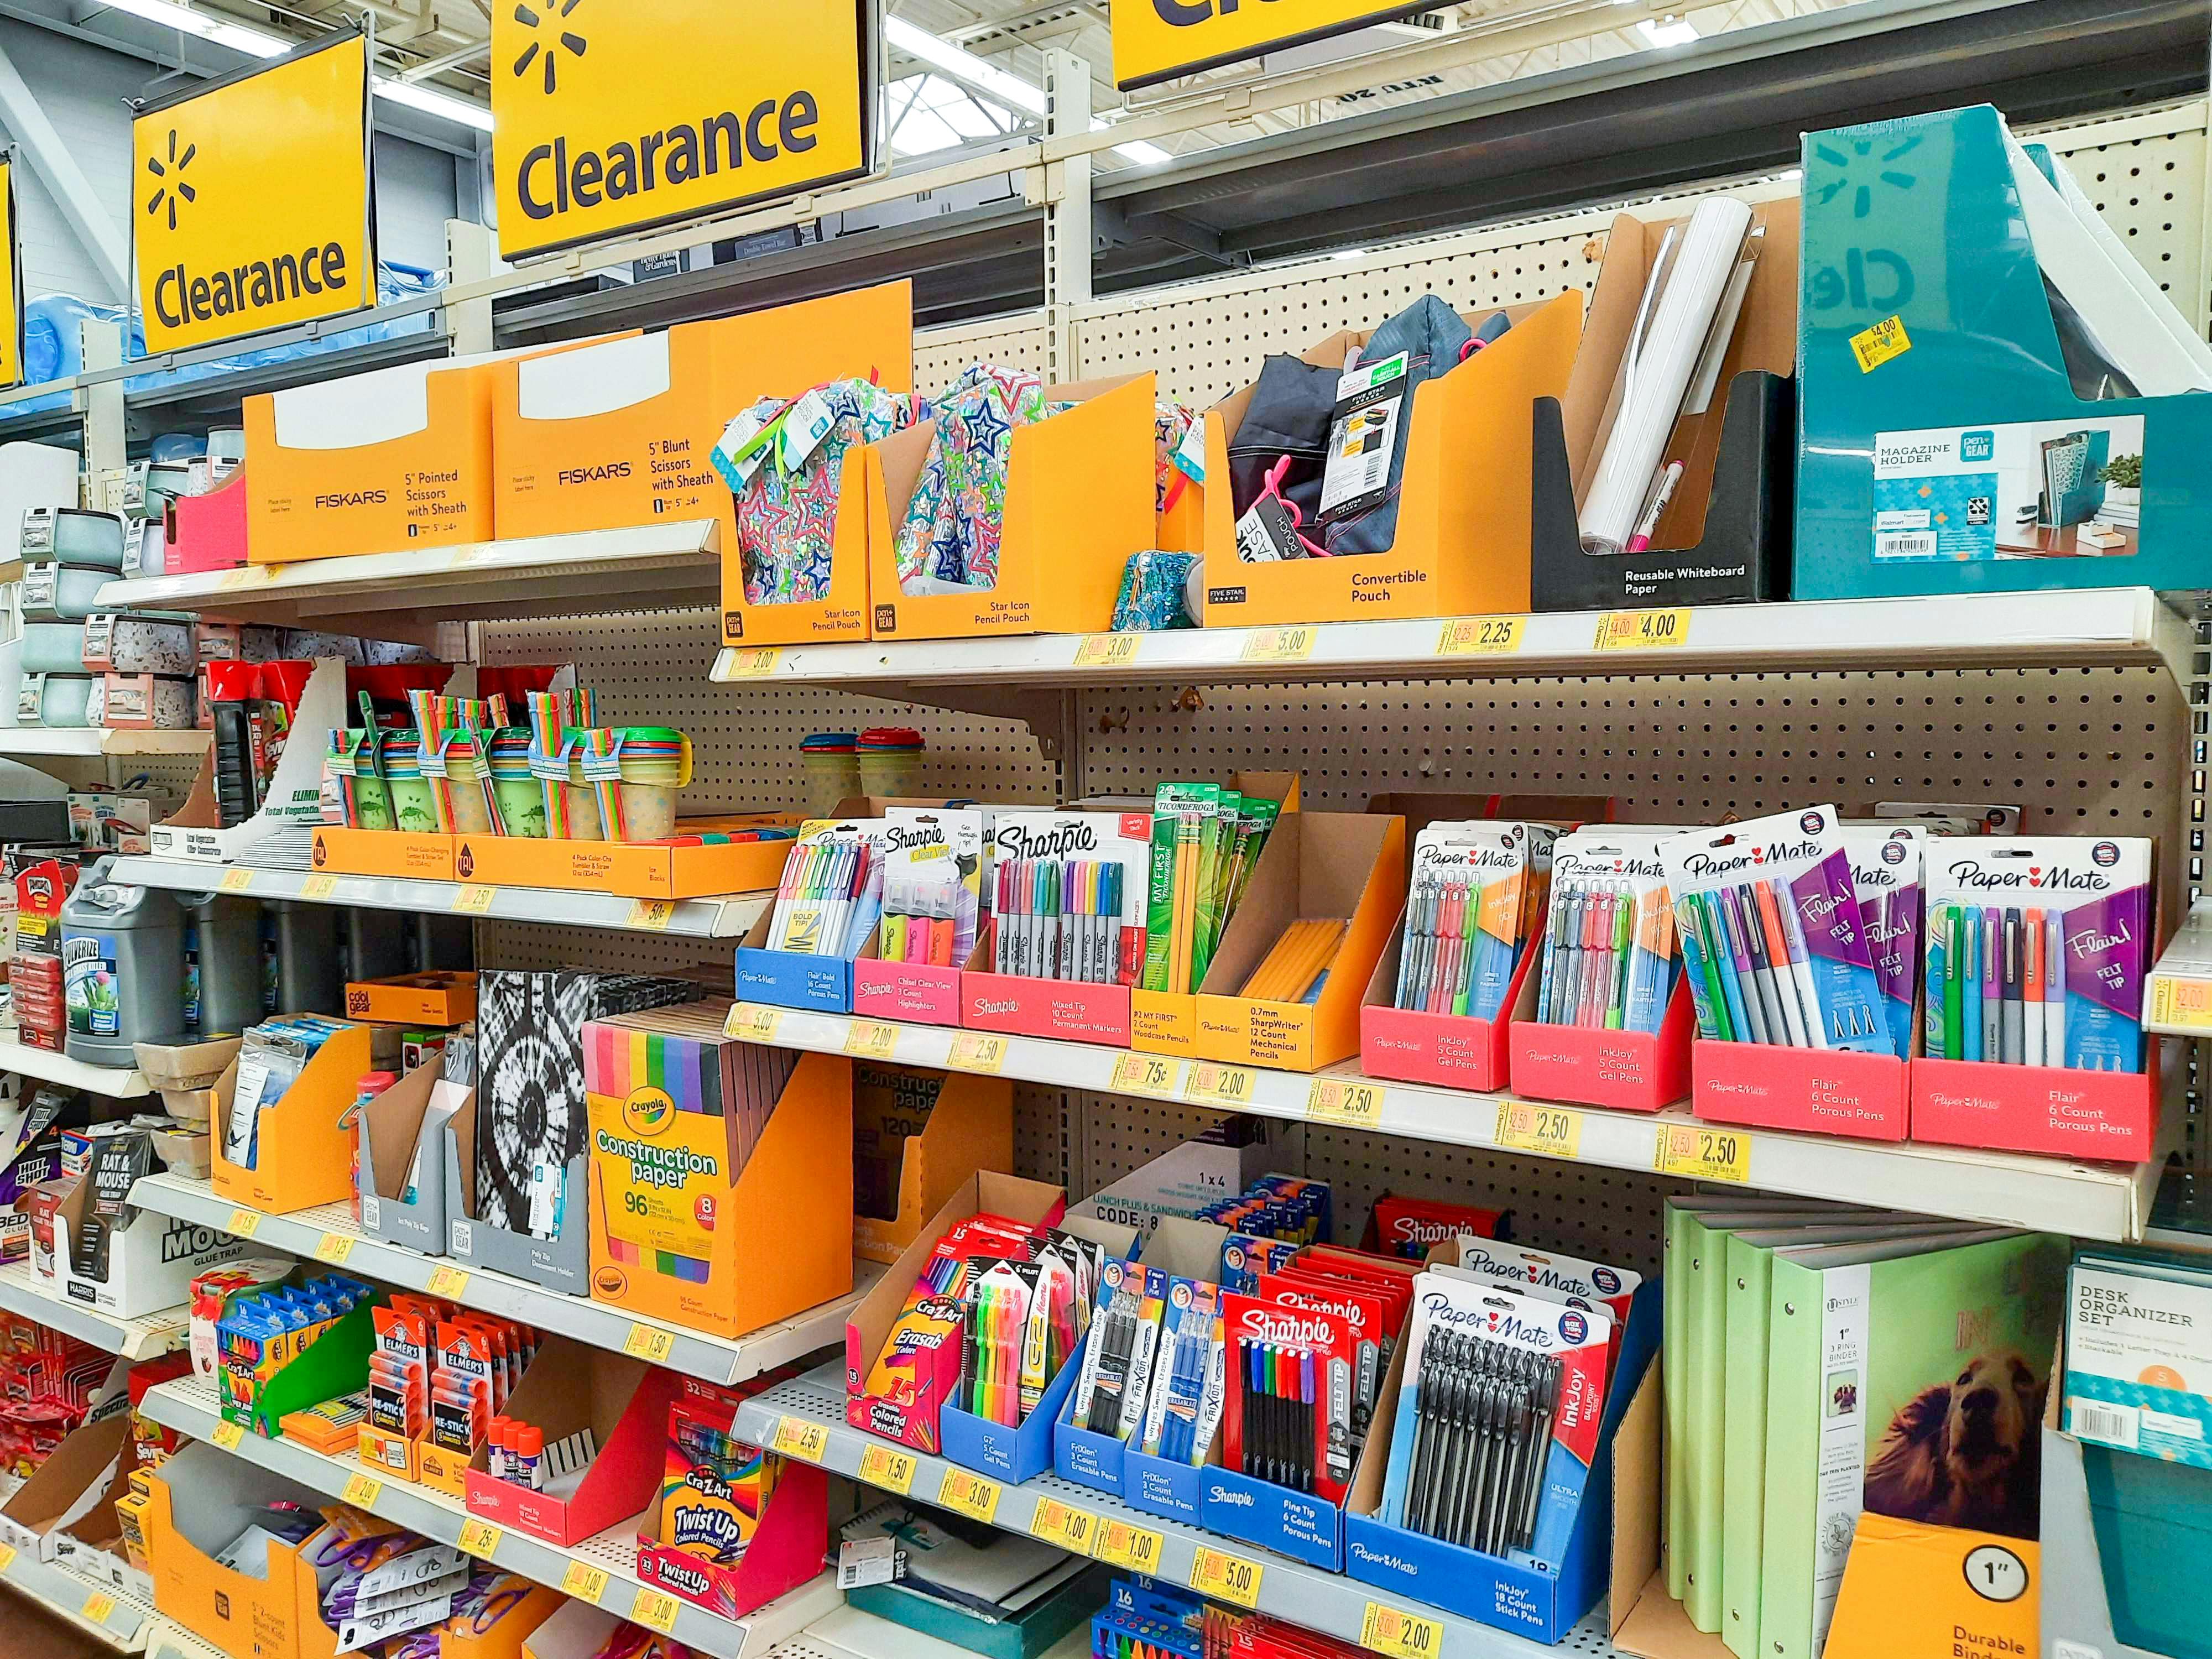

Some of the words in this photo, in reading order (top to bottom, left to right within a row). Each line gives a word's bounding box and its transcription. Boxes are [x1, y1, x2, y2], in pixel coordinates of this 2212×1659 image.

[518, 90, 818, 220] Clearance
[154, 242, 346, 328] Clearance
[1871, 319, 1896, 336] $4.00
[649, 442, 659, 455] 5"
[663, 439, 690, 454] Blunt
[1881, 444, 1950, 456] MAGAZINE
[1966, 445, 1989, 457] GEAR
[650, 459, 691, 474] Scissors
[1880, 455, 1932, 465] HOLDER
[559, 462, 632, 486] FISKARS
[652, 476, 674, 491] with
[677, 471, 714, 487] Sheath
[315, 490, 387, 509] FISKARS
[406, 489, 446, 501] Scissors
[407, 503, 429, 517] with
[432, 501, 467, 515] Sheath
[1277, 517, 1299, 552] POUCH
[1352, 570, 1427, 586] Convertible
[1626, 570, 1674, 582] Reusable
[1677, 565, 1745, 580] Whiteboard
[1352, 588, 1391, 602] Pouch
[1626, 584, 1657, 597] Paper
[812, 621, 835, 630] Pencil
[837, 619, 860, 629] Pouch
[975, 613, 999, 624] Pencil
[1001, 612, 1030, 623] Pouch
[1640, 614, 1676, 637] $4.00
[728, 623, 741, 634] GEAR
[1480, 622, 1513, 644] $2.25
[1279, 630, 1306, 651] $5.00
[885, 825, 945, 852] Sharpie
[997, 820, 1098, 862] Sharpie
[458, 855, 474, 870] TAL
[1417, 845, 1467, 871] Paper
[1475, 846, 1518, 869] Mate
[1684, 852, 1752, 880] Paper
[1766, 841, 1823, 866] Mate
[1949, 860, 2028, 891] Paper
[2041, 867, 2110, 890] Mate
[1799, 886, 1851, 924] Flair!
[1830, 920, 1851, 939] FELT
[1839, 932, 1855, 945] TIP
[2066, 918, 2132, 959] Flair!
[1880, 954, 1903, 969] FELT
[2097, 963, 2122, 980] FELT
[1889, 965, 1903, 979] TIP
[2106, 976, 2125, 991] TIP
[349, 990, 369, 1003] cool
[898, 999, 936, 1011] Highlighters
[1051, 1000, 1073, 1009] Mixed
[1074, 1001, 1086, 1011] Tip
[349, 1001, 371, 1015] gear
[973, 997, 1020, 1018] Sharpie
[1052, 1009, 1060, 1018] 10
[1061, 1010, 1084, 1021] Count
[1251, 1007, 1279, 1018] 0.7mm
[1052, 1019, 1091, 1031] Permanent
[1092, 1022, 1122, 1034] Markers
[1251, 1028, 1260, 1037] 12
[1261, 1029, 1286, 1040] Count
[1250, 1039, 1297, 1051] Mechanical
[1250, 1048, 1279, 1060] Pencils
[1438, 1057, 1454, 1068] Gel
[1455, 1058, 1478, 1071] Pens
[1218, 1072, 1245, 1095] $2.00
[1599, 1070, 1618, 1082] Gel
[1619, 1072, 1644, 1084] Pens
[631, 1098, 666, 1113] Crayola
[1344, 1087, 1372, 1113] $2.50
[1811, 1092, 1819, 1103] 6
[1822, 1093, 1859, 1107] Count
[1812, 1105, 1852, 1119] Porous
[1855, 1109, 1885, 1121] Pens
[2049, 1104, 2058, 1115] 6
[2060, 1105, 2103, 1119] Count
[1537, 1112, 1569, 1141] $2.50
[2049, 1118, 2095, 1133] Porous
[2100, 1121, 2132, 1136] Pens
[596, 1129, 717, 1176] Construction
[1700, 1134, 1736, 1164] $2.50
[16, 1166, 50, 1186] SHOT
[19, 1157, 46, 1175] HOT
[632, 1160, 687, 1189] paper
[95, 1172, 131, 1190] MOUSE
[625, 1191, 648, 1217] 96
[1096, 1206, 1144, 1228] CODE:
[1150, 1215, 1159, 1230] 8
[5, 1224, 29, 1234] GLUE
[194, 1251, 218, 1266] GLUE
[220, 1246, 243, 1259] TRAP
[1465, 1248, 1528, 1282] Paper
[1539, 1272, 1590, 1298] Mate
[70, 1283, 95, 1298] HARRIS
[2080, 1285, 2129, 1303] DESK
[1422, 1292, 1487, 1331] Paper
[1497, 1317, 1554, 1348] Mate
[2079, 1298, 2194, 1328] ORGANIZER
[2079, 1311, 2114, 1327] SET
[1241, 1308, 1336, 1344] Sharpie
[386, 1338, 419, 1359] ELMER'S
[1360, 1345, 1373, 1369] TIP
[448, 1354, 483, 1374] ELMER'S
[686, 1380, 701, 1396] 32
[886, 1376, 916, 1405] 15
[1358, 1370, 1371, 1402] FELT
[1562, 1367, 1587, 1428] InkJoy
[869, 1404, 907, 1427] Colored
[435, 1416, 471, 1436] RE-STICK
[869, 1418, 903, 1438] Pencils
[984, 1454, 995, 1463] Gel
[996, 1457, 1011, 1469] Pens
[1071, 1463, 1097, 1479] Erasable
[1099, 1470, 1118, 1483] Pens
[1143, 1490, 1171, 1508] Erasable
[1172, 1500, 1193, 1512] Pens
[1207, 1485, 1254, 1509] Sharpie
[1283, 1499, 1300, 1513] Fine
[1301, 1503, 1316, 1519] Tip
[675, 1506, 714, 1532] Twist
[714, 1511, 739, 1543] Up
[1062, 1513, 1086, 1541] $1.00
[675, 1532, 700, 1545] Colored
[700, 1533, 725, 1549] Pencils
[1283, 1524, 1310, 1540] Porous
[1312, 1531, 1332, 1548] Pens
[1128, 1531, 1152, 1562] $1.00
[1351, 1542, 1385, 1568] Paper
[1389, 1555, 1418, 1575] Mate
[658, 1556, 688, 1583] Twist
[687, 1572, 711, 1593] Up
[1227, 1561, 1253, 1592] $5.00
[1983, 1560, 2009, 1585] 1"
[1495, 1579, 1529, 1598] InkJoy
[1495, 1591, 1505, 1603] 18
[1507, 1594, 1538, 1613] Count
[1495, 1602, 1520, 1619] Stick
[1521, 1609, 1543, 1627] Pens
[1401, 1621, 1431, 1651] $2.00
[1953, 1625, 2026, 1656] Durable
